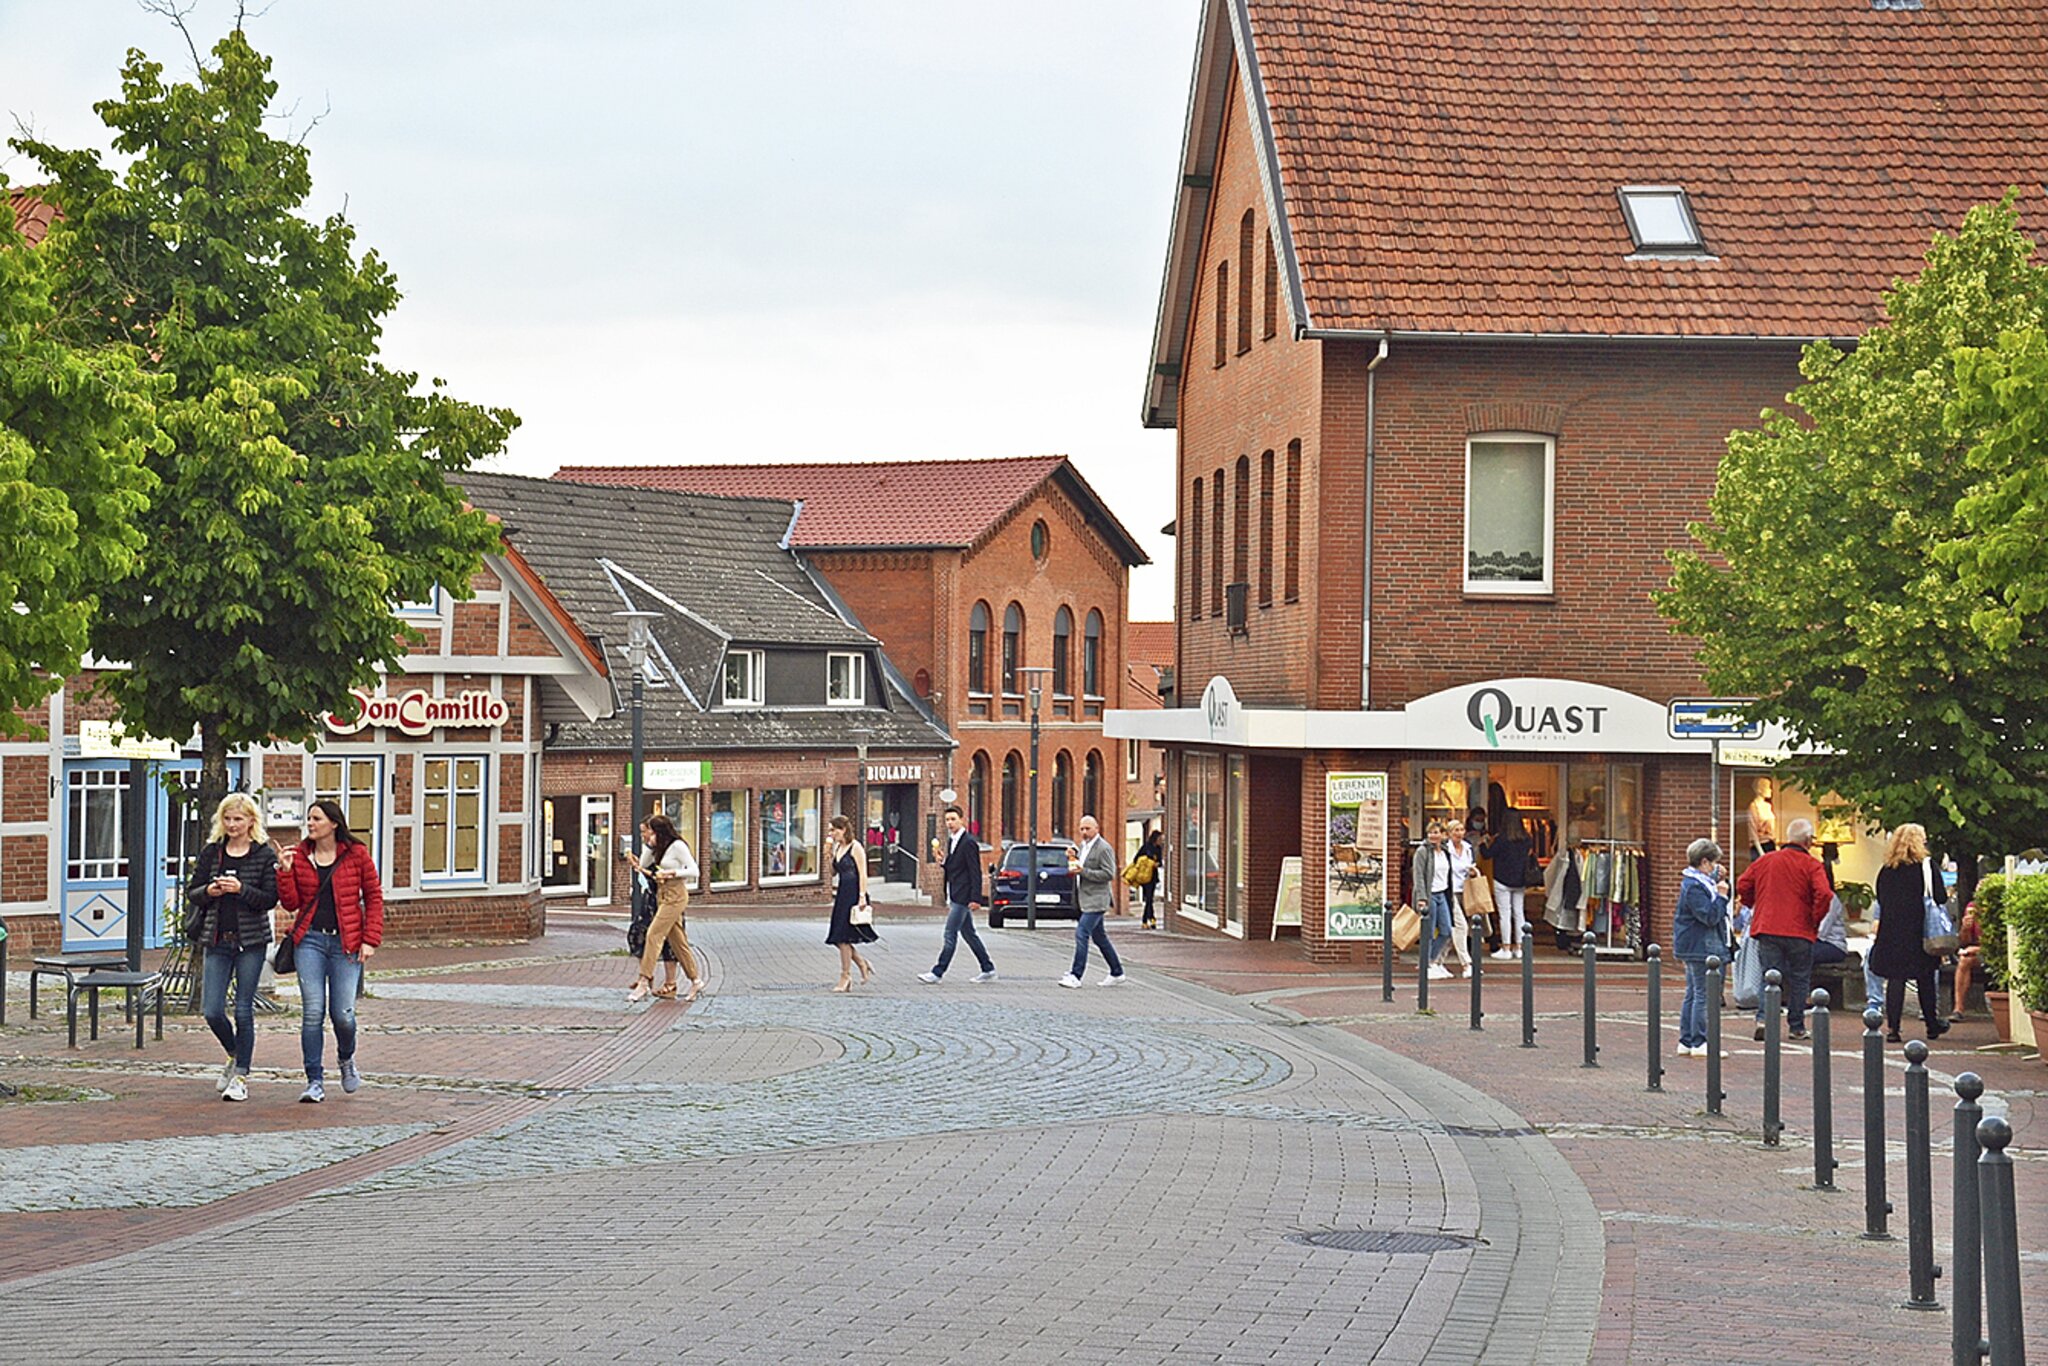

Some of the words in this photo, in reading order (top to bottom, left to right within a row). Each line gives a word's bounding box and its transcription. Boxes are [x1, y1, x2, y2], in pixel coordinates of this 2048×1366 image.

[400, 693, 503, 728] Camillo
[1467, 688, 1608, 747] QUAST
[866, 765, 922, 781] BIOLADEN
[1332, 780, 1366, 791] LEBEN
[1368, 779, 1381, 789] IM
[1333, 789, 1382, 802] GRÜNEN!
[1331, 911, 1382, 936] QUAST
